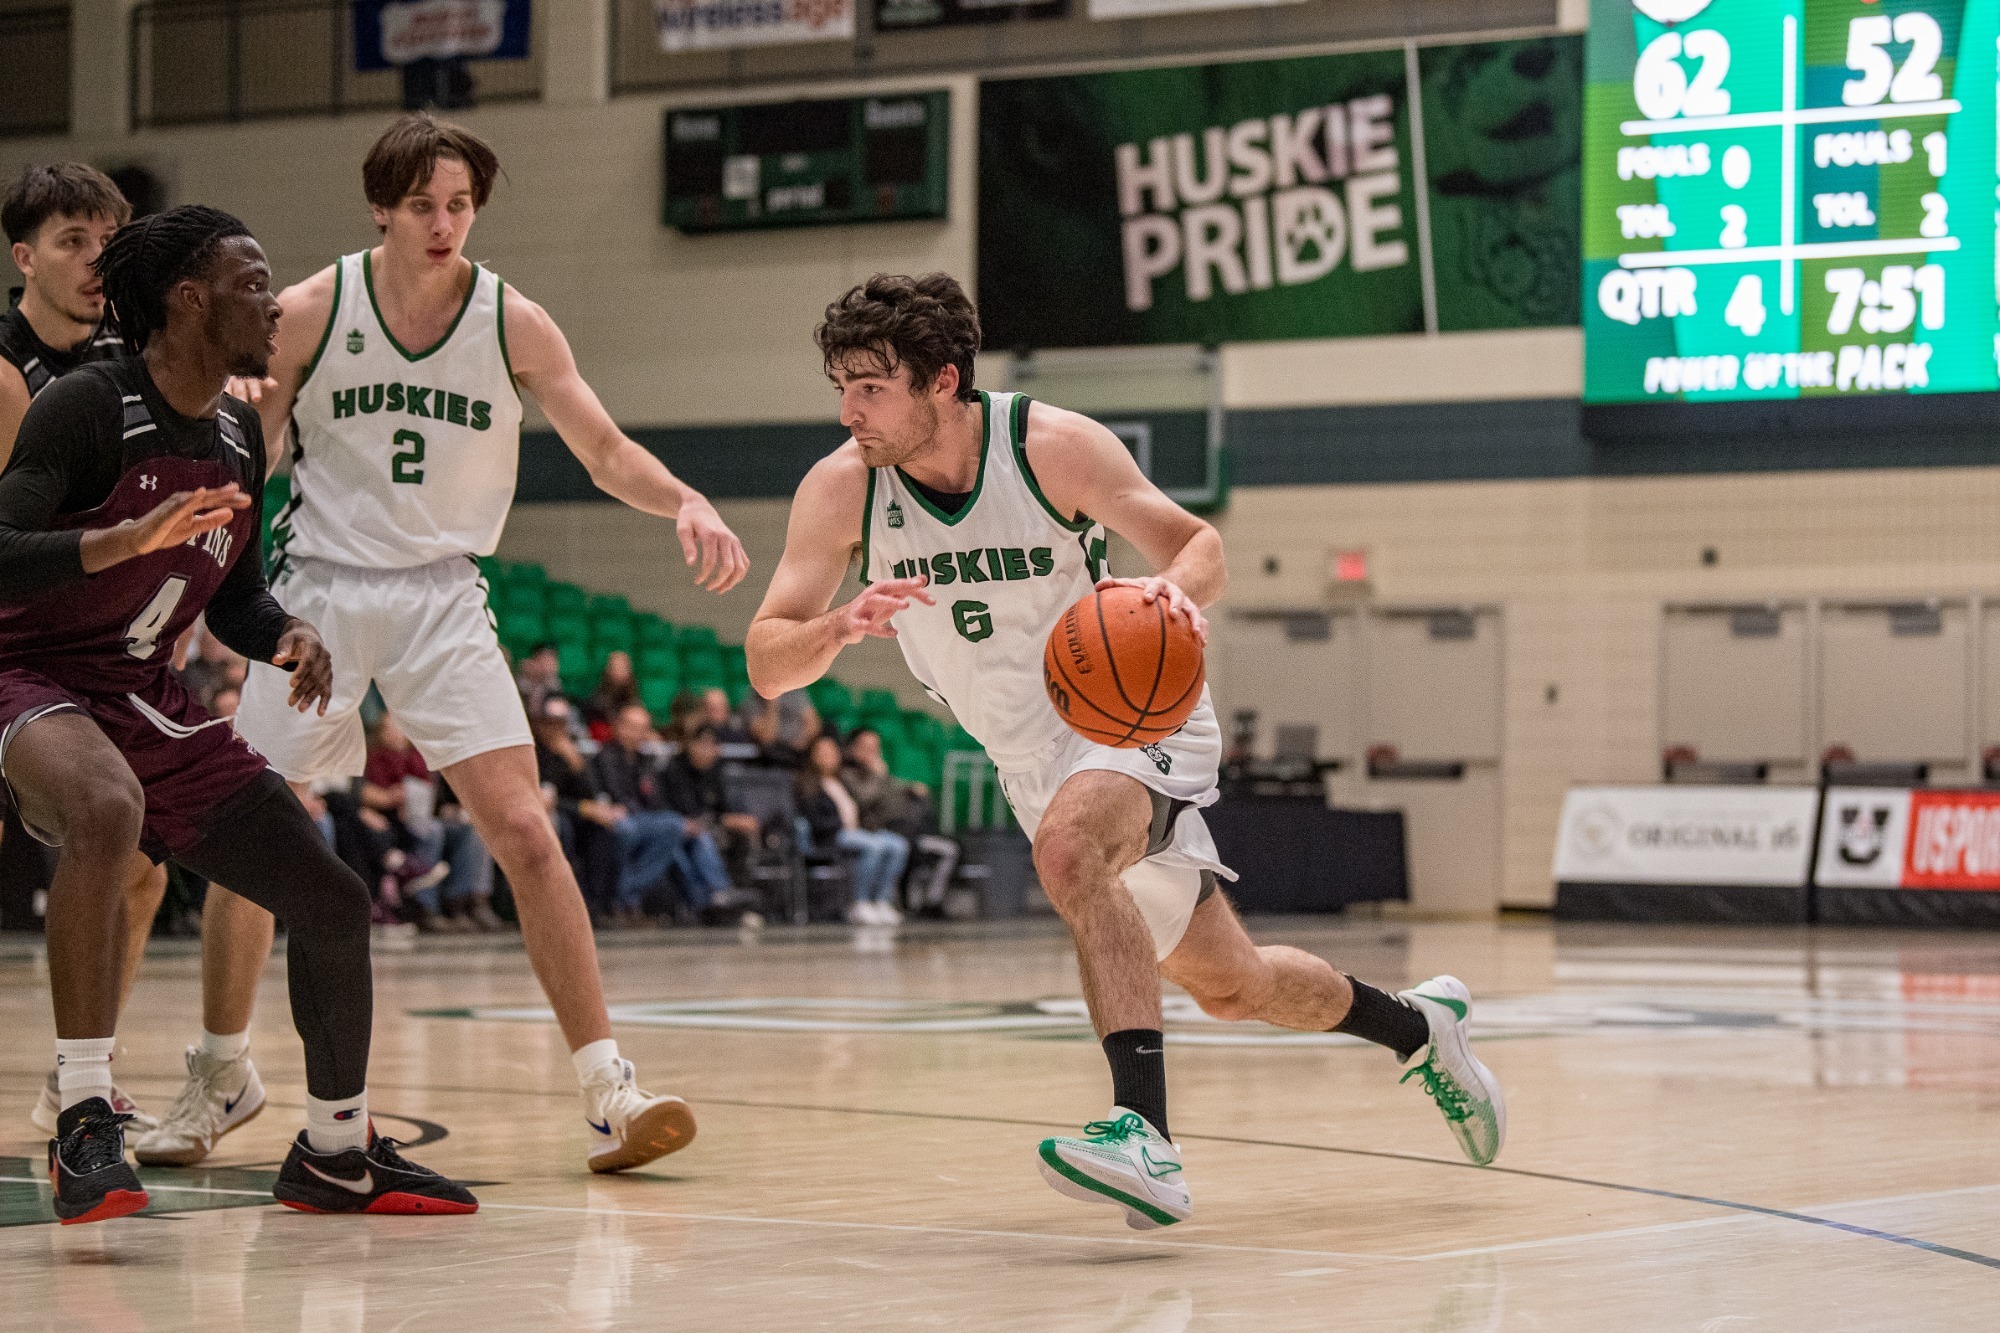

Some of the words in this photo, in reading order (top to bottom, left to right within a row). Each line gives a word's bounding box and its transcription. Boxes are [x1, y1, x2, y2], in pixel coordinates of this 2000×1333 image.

[1634, 29, 1731, 120] 62
[1842, 12, 1943, 107] 52
[1115, 94, 1399, 215] HUSKIE
[1617, 143, 1711, 181] FOULS
[1722, 145, 1751, 189] 0
[1814, 130, 1912, 168] FOULS
[1923, 131, 1947, 177] 1
[1121, 172, 1408, 312] PRIDE
[1616, 204, 1675, 239] TOL
[1720, 204, 1748, 249] 2
[1813, 192, 1875, 228] TOL
[1920, 193, 1948, 237] 2
[1598, 268, 1697, 325] QTR
[1725, 275, 1766, 336] 4
[1825, 265, 1945, 334] 7:51
[1643, 356, 1740, 393] POWER
[1836, 342, 1933, 391] PACK
[332, 382, 492, 431] HUSKIES
[392, 428, 425, 484] 2
[124, 576, 188, 660] 4
